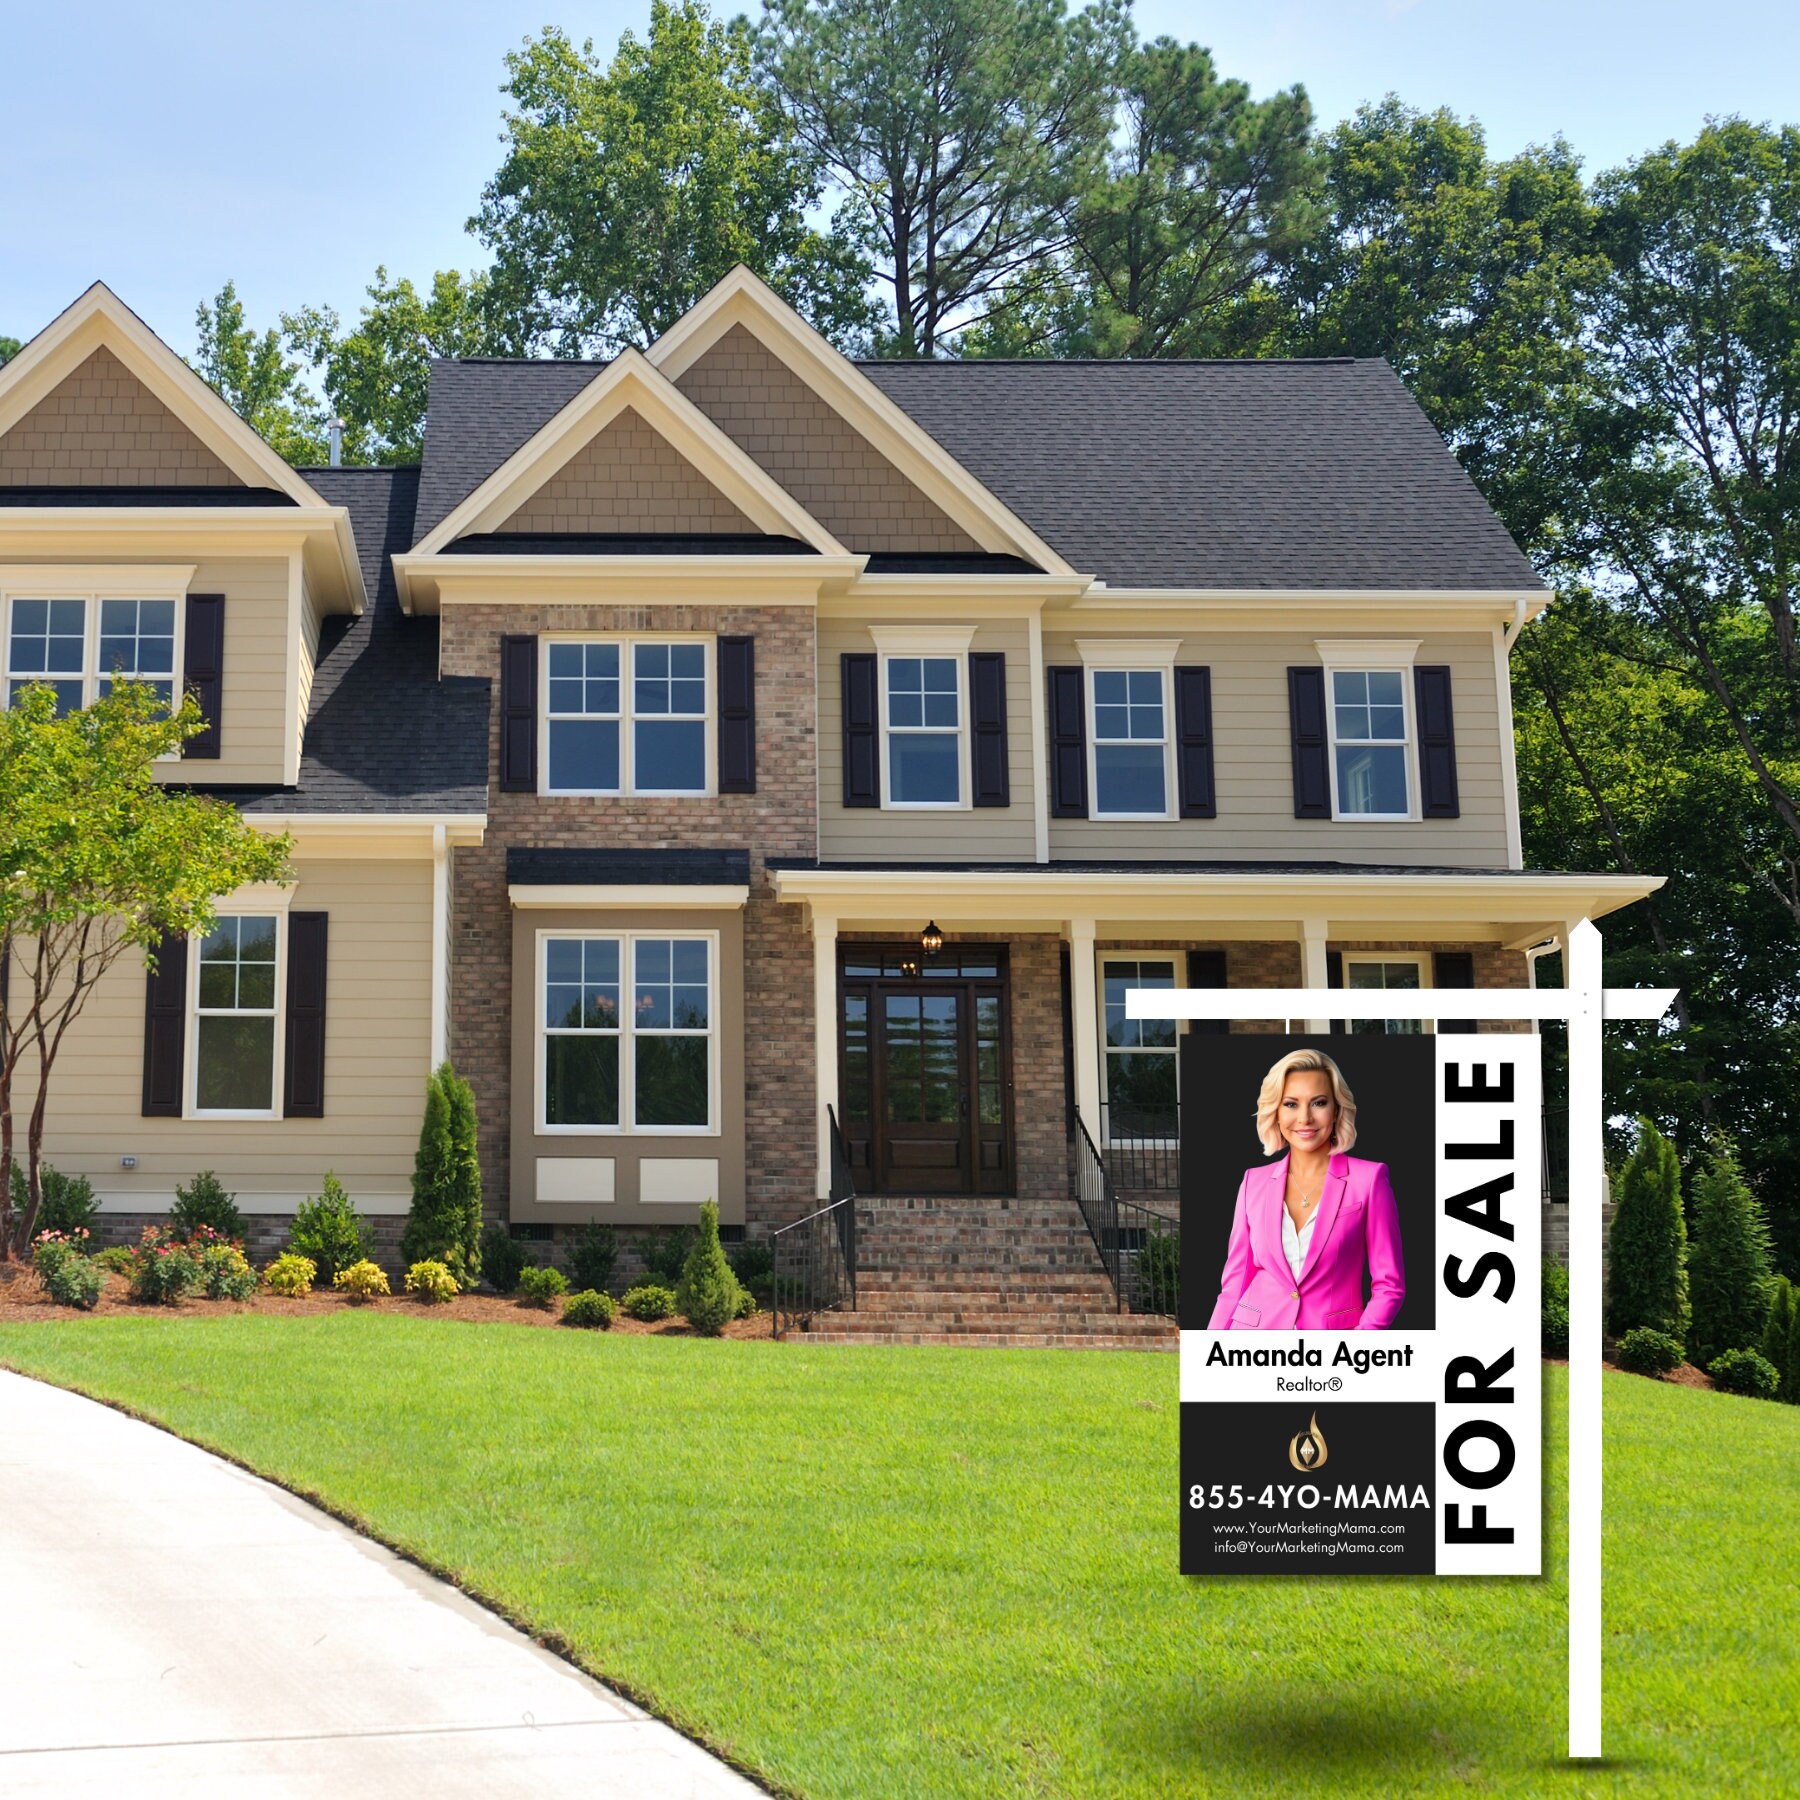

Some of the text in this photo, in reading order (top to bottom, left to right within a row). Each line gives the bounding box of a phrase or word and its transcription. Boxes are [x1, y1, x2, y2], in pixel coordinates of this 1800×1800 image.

[1444, 1062, 1516, 1545] FOR SALE
[1206, 1339, 1414, 1375] Amanda Agent
[1189, 1484, 1431, 1510] 855-4YO-MAMA
[1212, 1521, 1405, 1537] www.YourMarketingMama.com
[1214, 1540, 1404, 1557] info@YourMarketingMama.com
